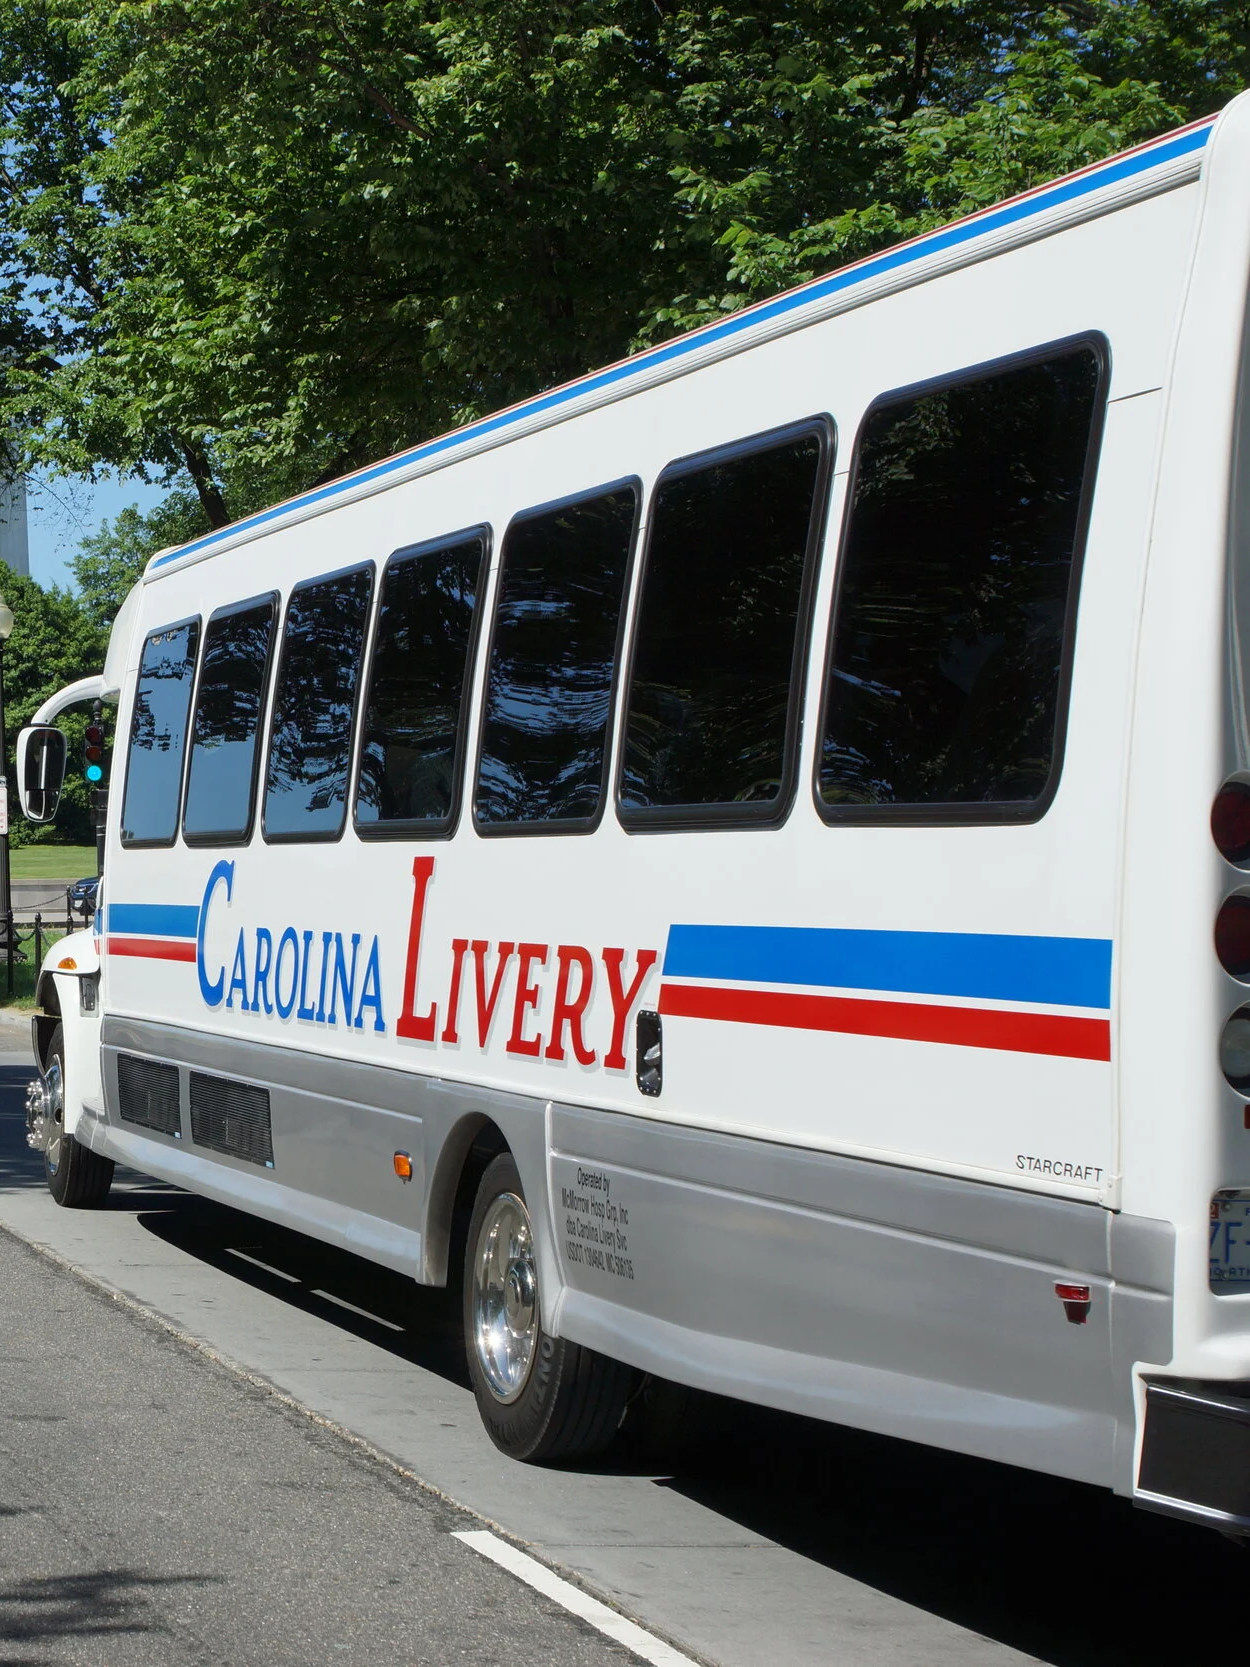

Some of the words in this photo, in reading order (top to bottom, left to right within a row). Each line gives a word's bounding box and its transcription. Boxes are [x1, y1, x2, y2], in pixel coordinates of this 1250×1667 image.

[197, 859, 386, 1033] CAROLINA
[396, 856, 658, 1070] LIVERY
[577, 1167, 603, 1191] Operated
[603, 1173, 611, 1197] by
[1015, 1154, 1104, 1183] STARCRAFT
[562, 1187, 590, 1214] McMorrow
[590, 1196, 606, 1223] Hosp
[577, 1217, 599, 1244] Carolina
[599, 1223, 616, 1253] Livery
[616, 1228, 628, 1252] Svc
